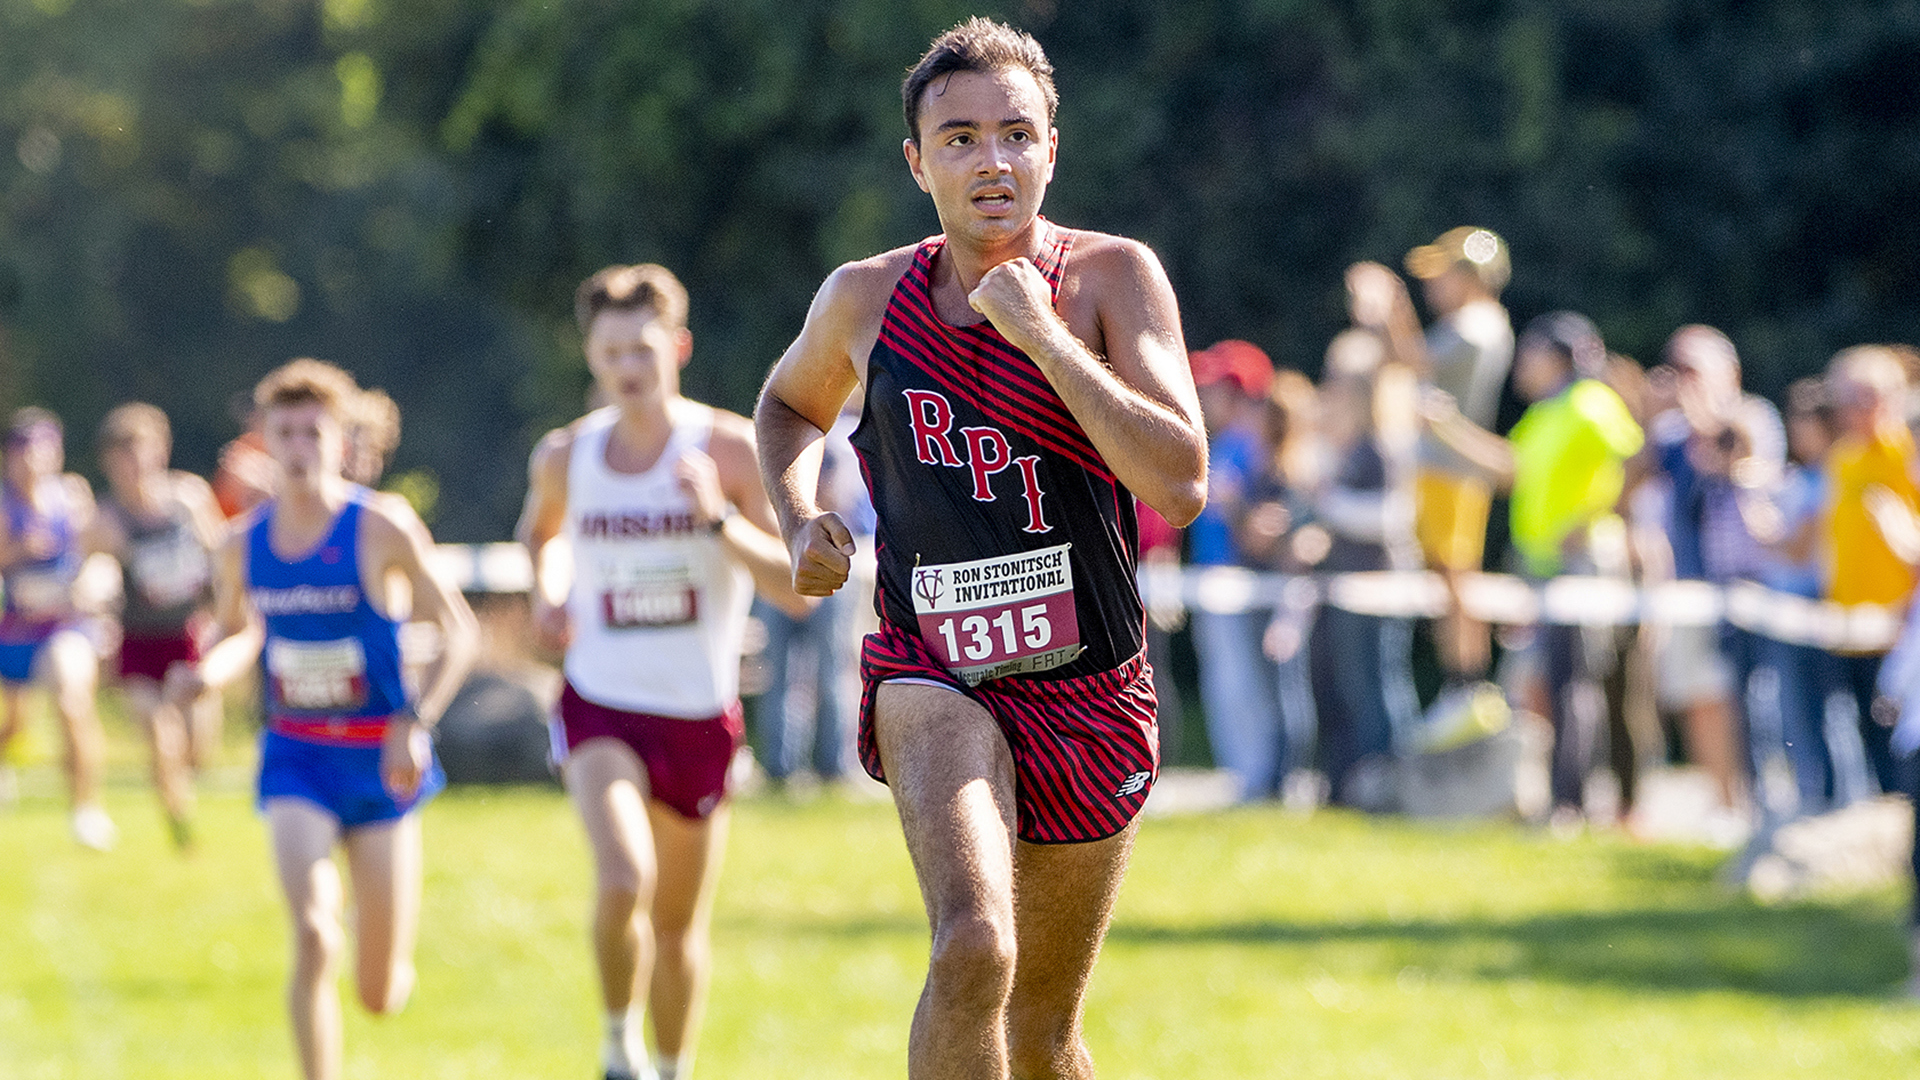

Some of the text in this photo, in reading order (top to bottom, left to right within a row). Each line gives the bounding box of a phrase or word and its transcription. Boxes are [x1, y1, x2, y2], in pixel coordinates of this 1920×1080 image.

[902, 388, 1054, 533] RPI
[953, 553, 1063, 585] RON STONITSCH
[955, 569, 1065, 603] INVITATIONAL
[938, 603, 1052, 662] 1315
